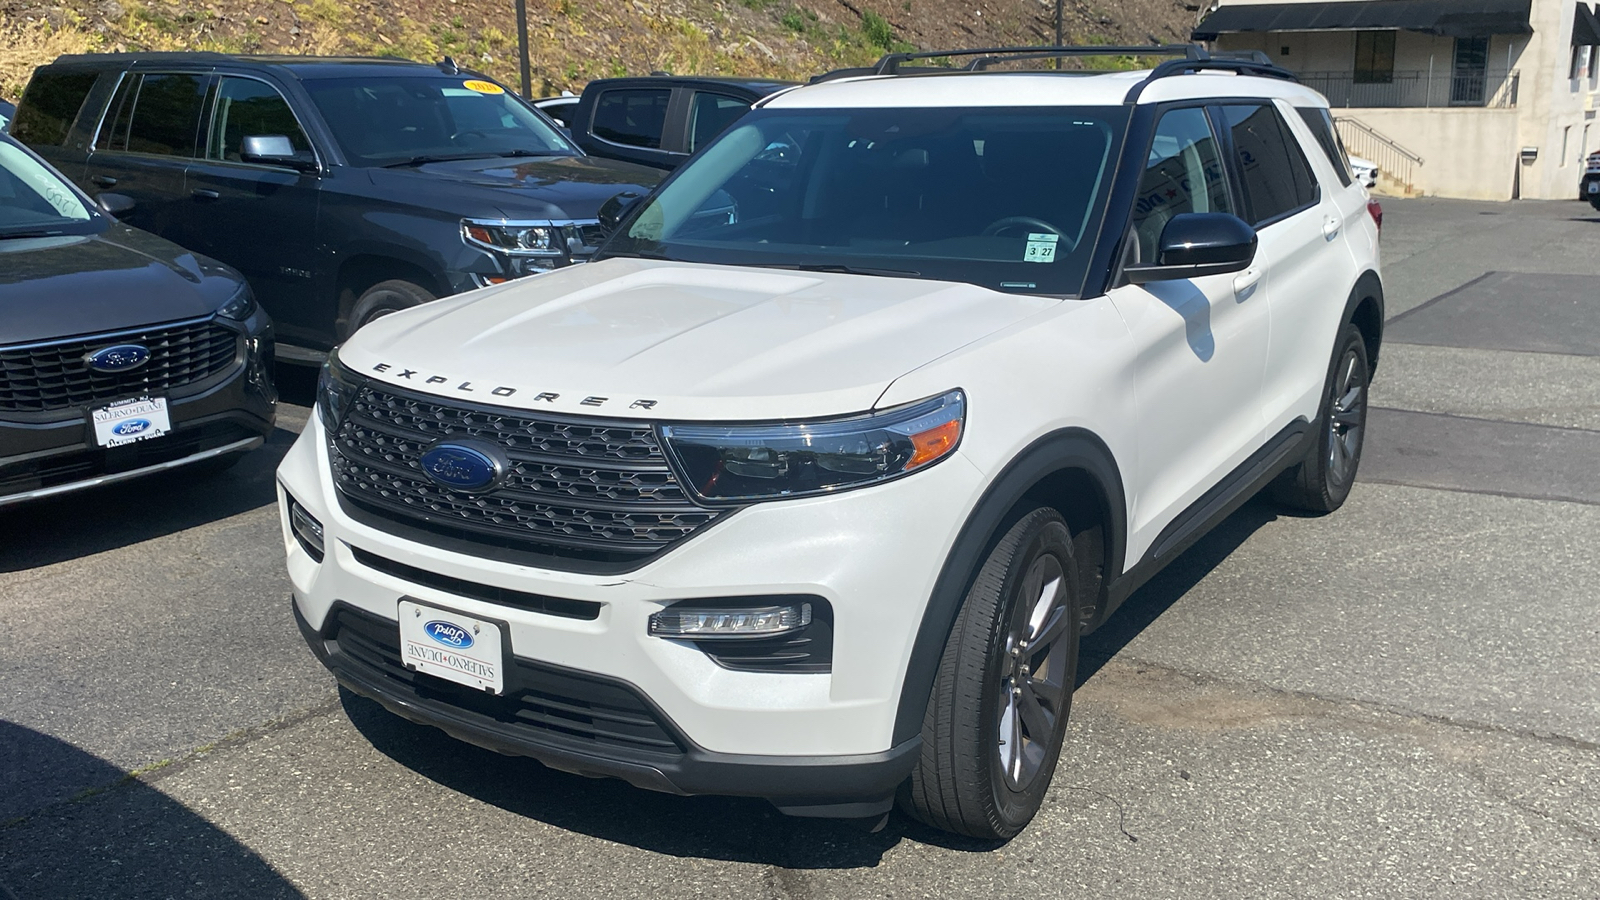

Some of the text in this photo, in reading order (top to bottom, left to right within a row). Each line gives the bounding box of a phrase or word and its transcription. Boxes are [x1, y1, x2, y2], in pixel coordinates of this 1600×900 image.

[470, 82, 498, 92] 2020
[1029, 247, 1053, 257] 3 27
[372, 362, 659, 411] EXPLORER
[120, 421, 144, 435] Ford
[434, 623, 465, 646] Ford
[407, 643, 495, 679] SALERNO DUANE
